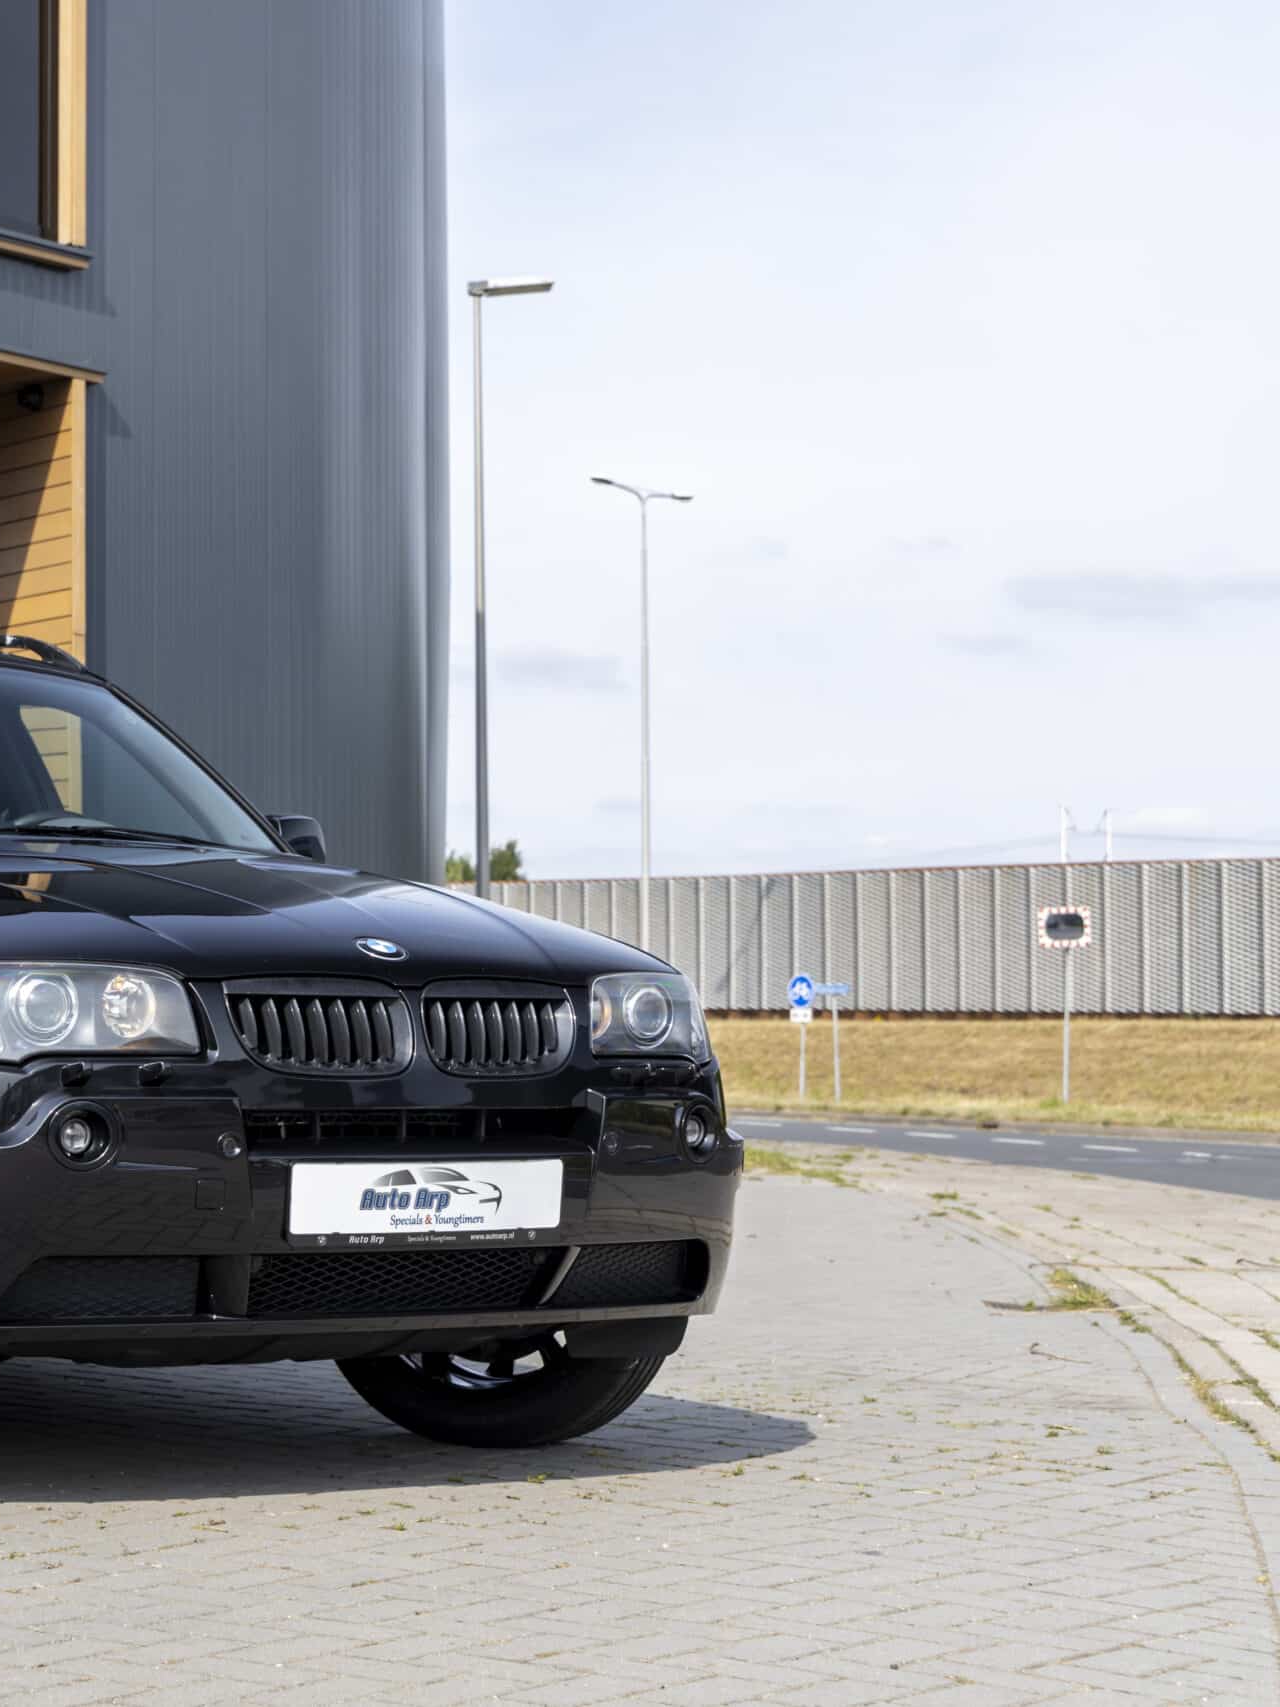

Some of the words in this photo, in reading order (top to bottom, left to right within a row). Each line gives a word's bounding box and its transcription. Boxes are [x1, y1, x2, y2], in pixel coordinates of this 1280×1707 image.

[360, 1188, 411, 1210] Auto
[414, 1188, 451, 1213] Arp
[390, 1213, 423, 1229] Specials
[434, 1214, 485, 1229] Youngtimers
